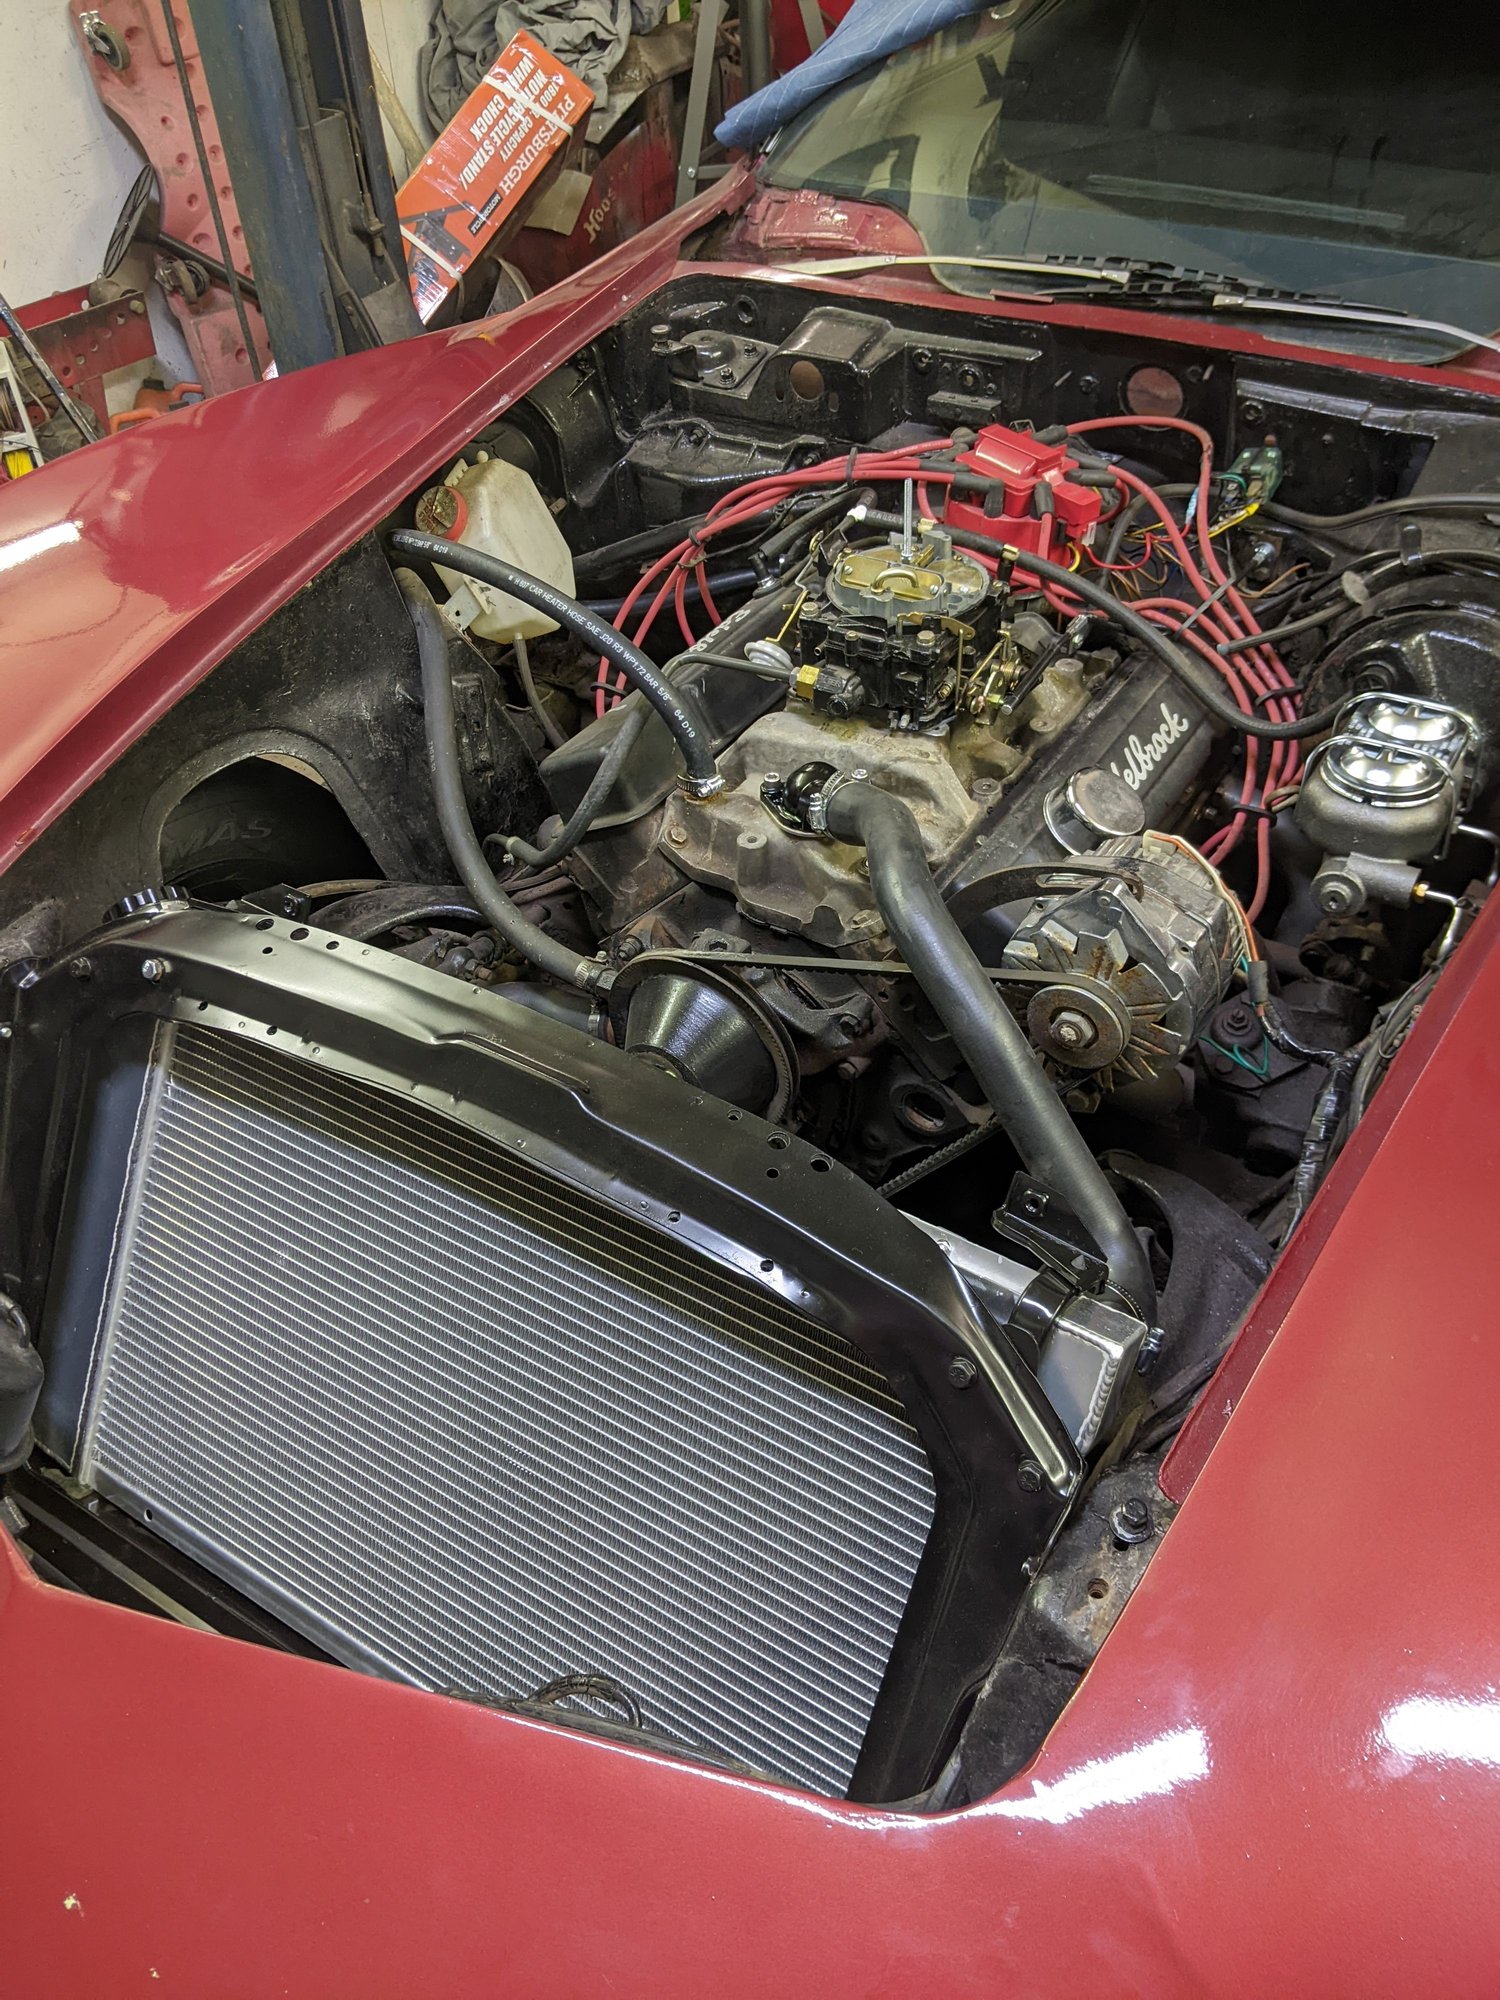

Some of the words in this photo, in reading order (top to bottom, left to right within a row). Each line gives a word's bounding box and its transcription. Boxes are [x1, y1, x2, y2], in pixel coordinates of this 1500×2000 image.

[468, 94, 504, 141] CHOCK
[488, 69, 548, 149] MOTRCYCLE
[540, 80, 560, 107] 1800
[458, 139, 495, 191] STAND/
[498, 93, 576, 196] PITTSBURGH
[500, 117, 534, 163] CAPACITY
[470, 193, 501, 234] MOTORCYCLE
[529, 584, 543, 597] CAR
[542, 593, 567, 612] HEATER
[567, 609, 586, 625] HOSE
[585, 621, 601, 636] SAE
[599, 633, 613, 645] J20
[612, 642, 624, 653] R3
[643, 673, 659, 689] BAR
[1110, 703, 1189, 790] elbrock
